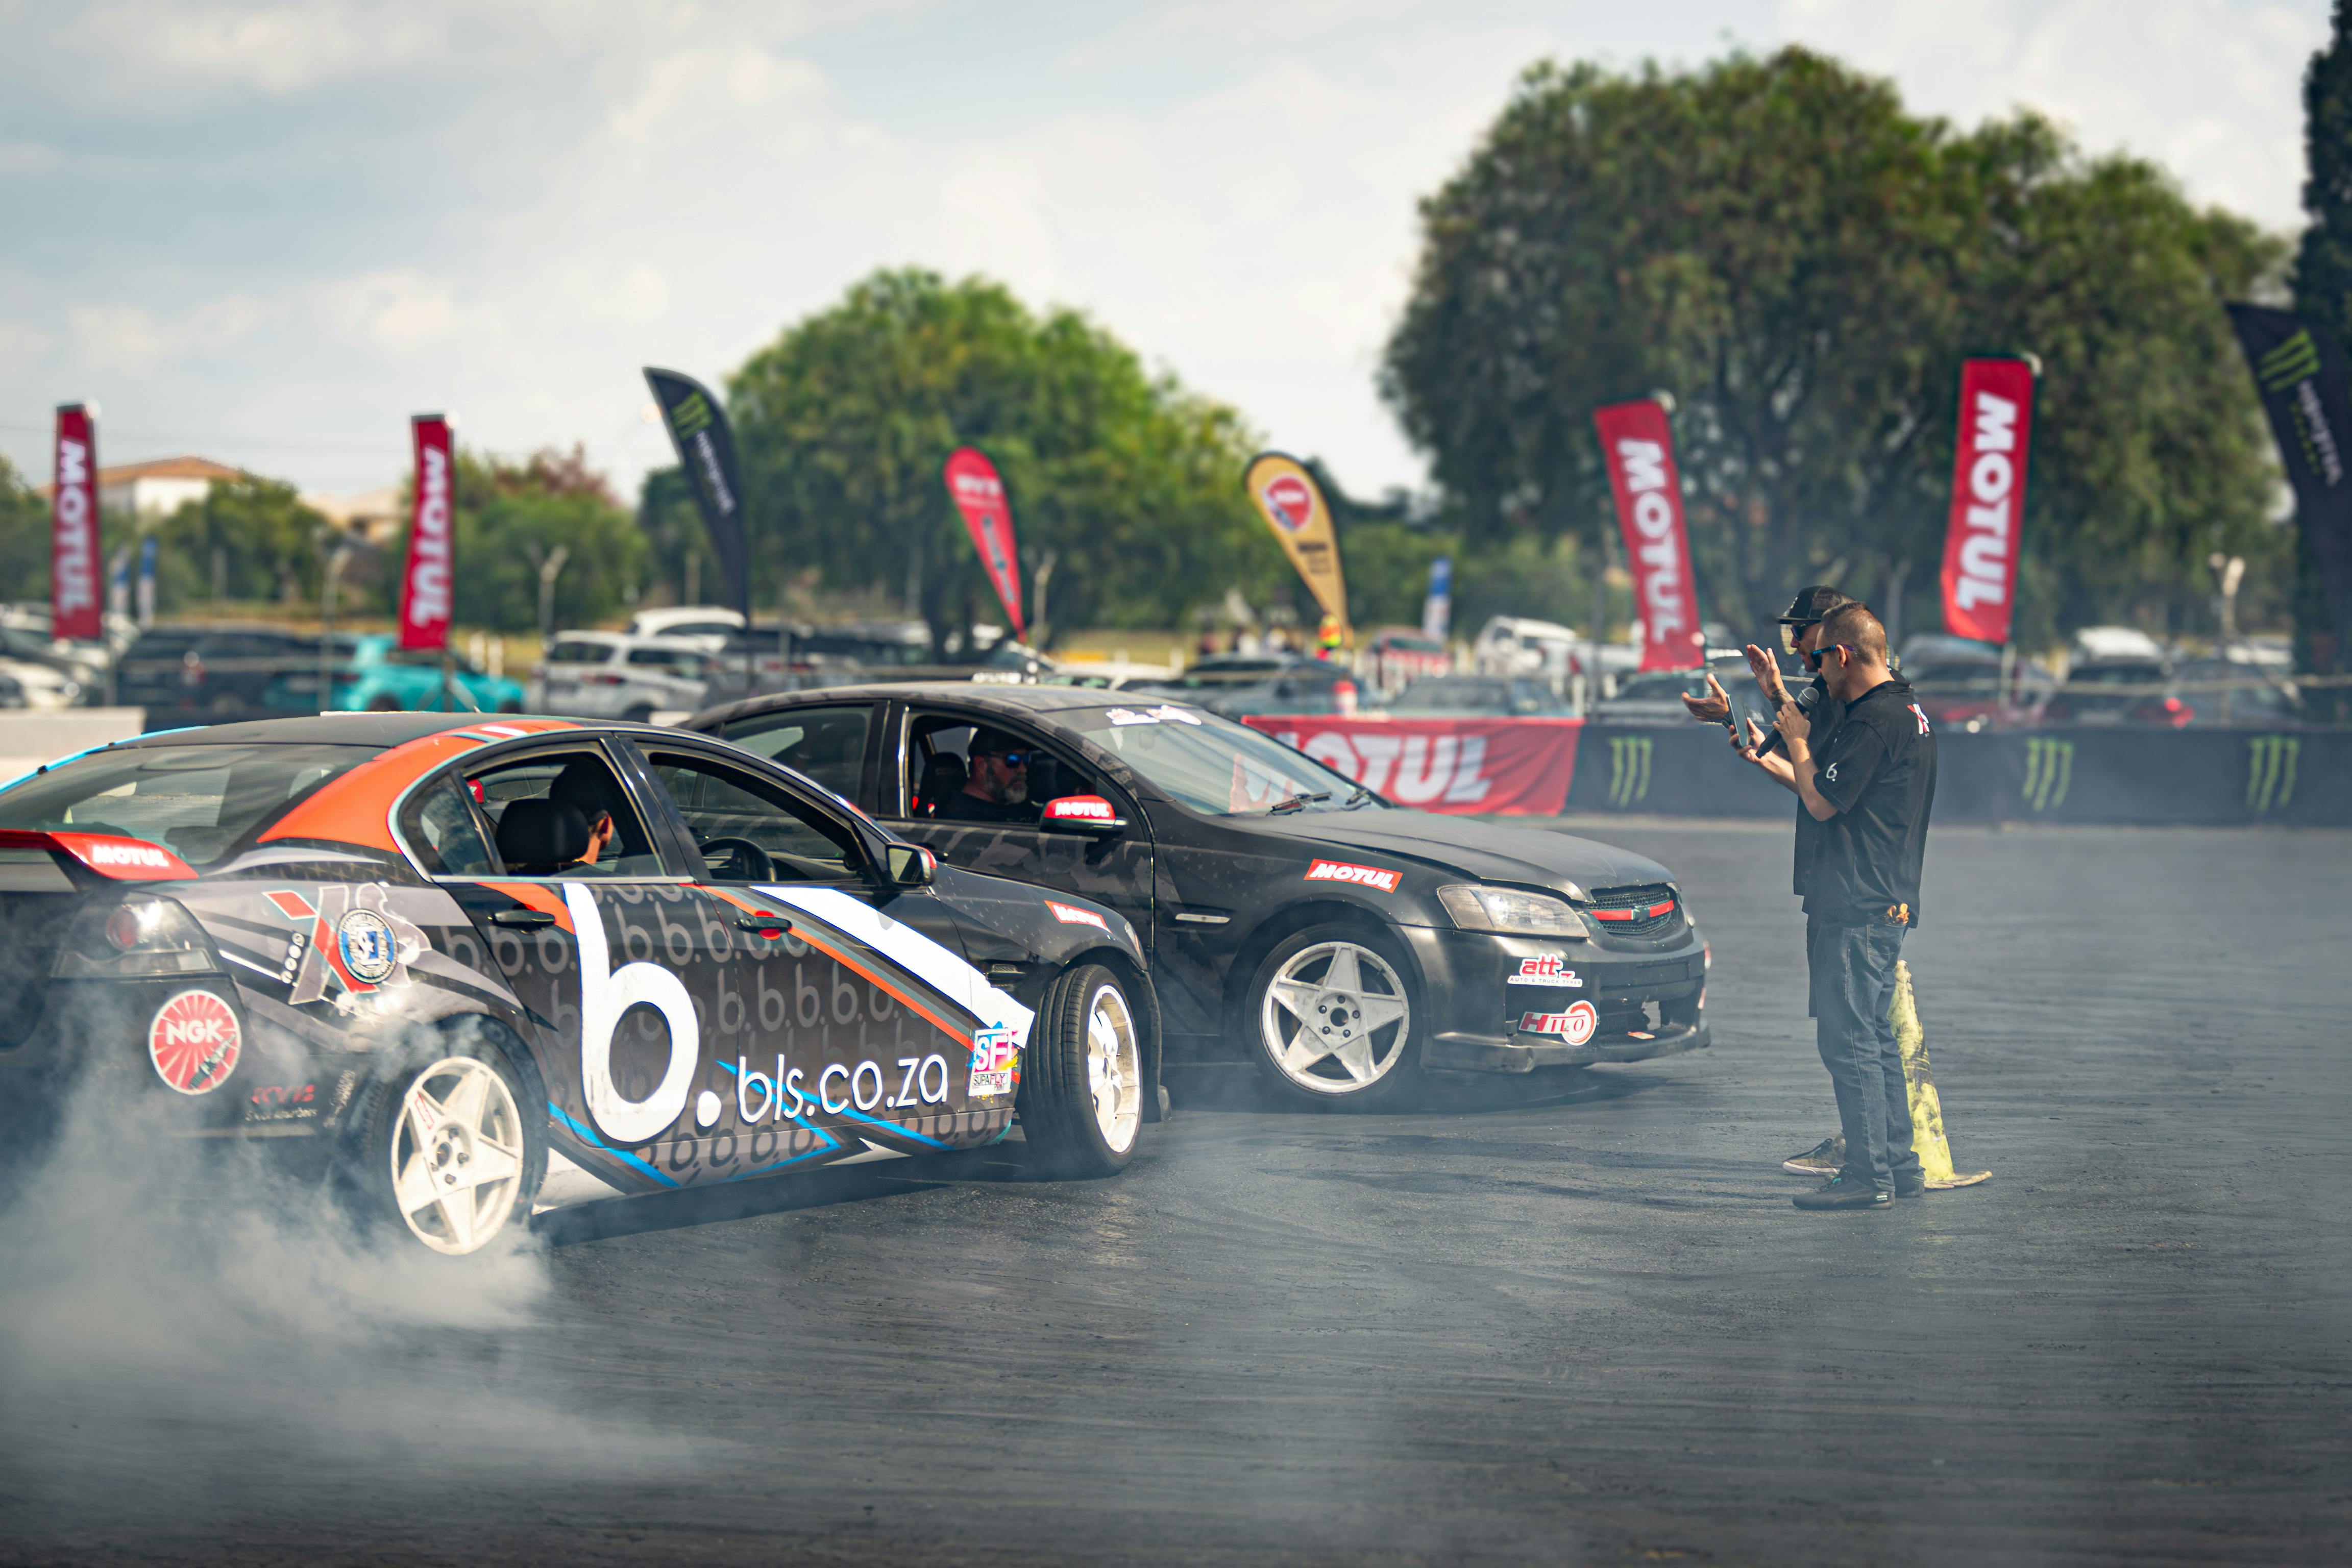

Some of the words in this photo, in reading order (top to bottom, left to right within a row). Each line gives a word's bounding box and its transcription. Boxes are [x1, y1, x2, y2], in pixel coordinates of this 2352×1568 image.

[1955, 390, 2017, 611] MOTUL
[58, 439, 92, 617] MOTUL
[409, 447, 449, 628] MOTUL
[1618, 438, 1683, 643] MOTUL
[1055, 802, 1110, 817] MOTUL
[92, 846, 169, 867] MOTUL
[1309, 863, 1394, 889] MOTUL
[1522, 955, 1560, 975] att
[166, 1019, 225, 1045] NGK
[975, 1036, 1008, 1071] SF
[738, 1054, 949, 1123] bls.co.za
[972, 1073, 1006, 1086] SUPAFLY
